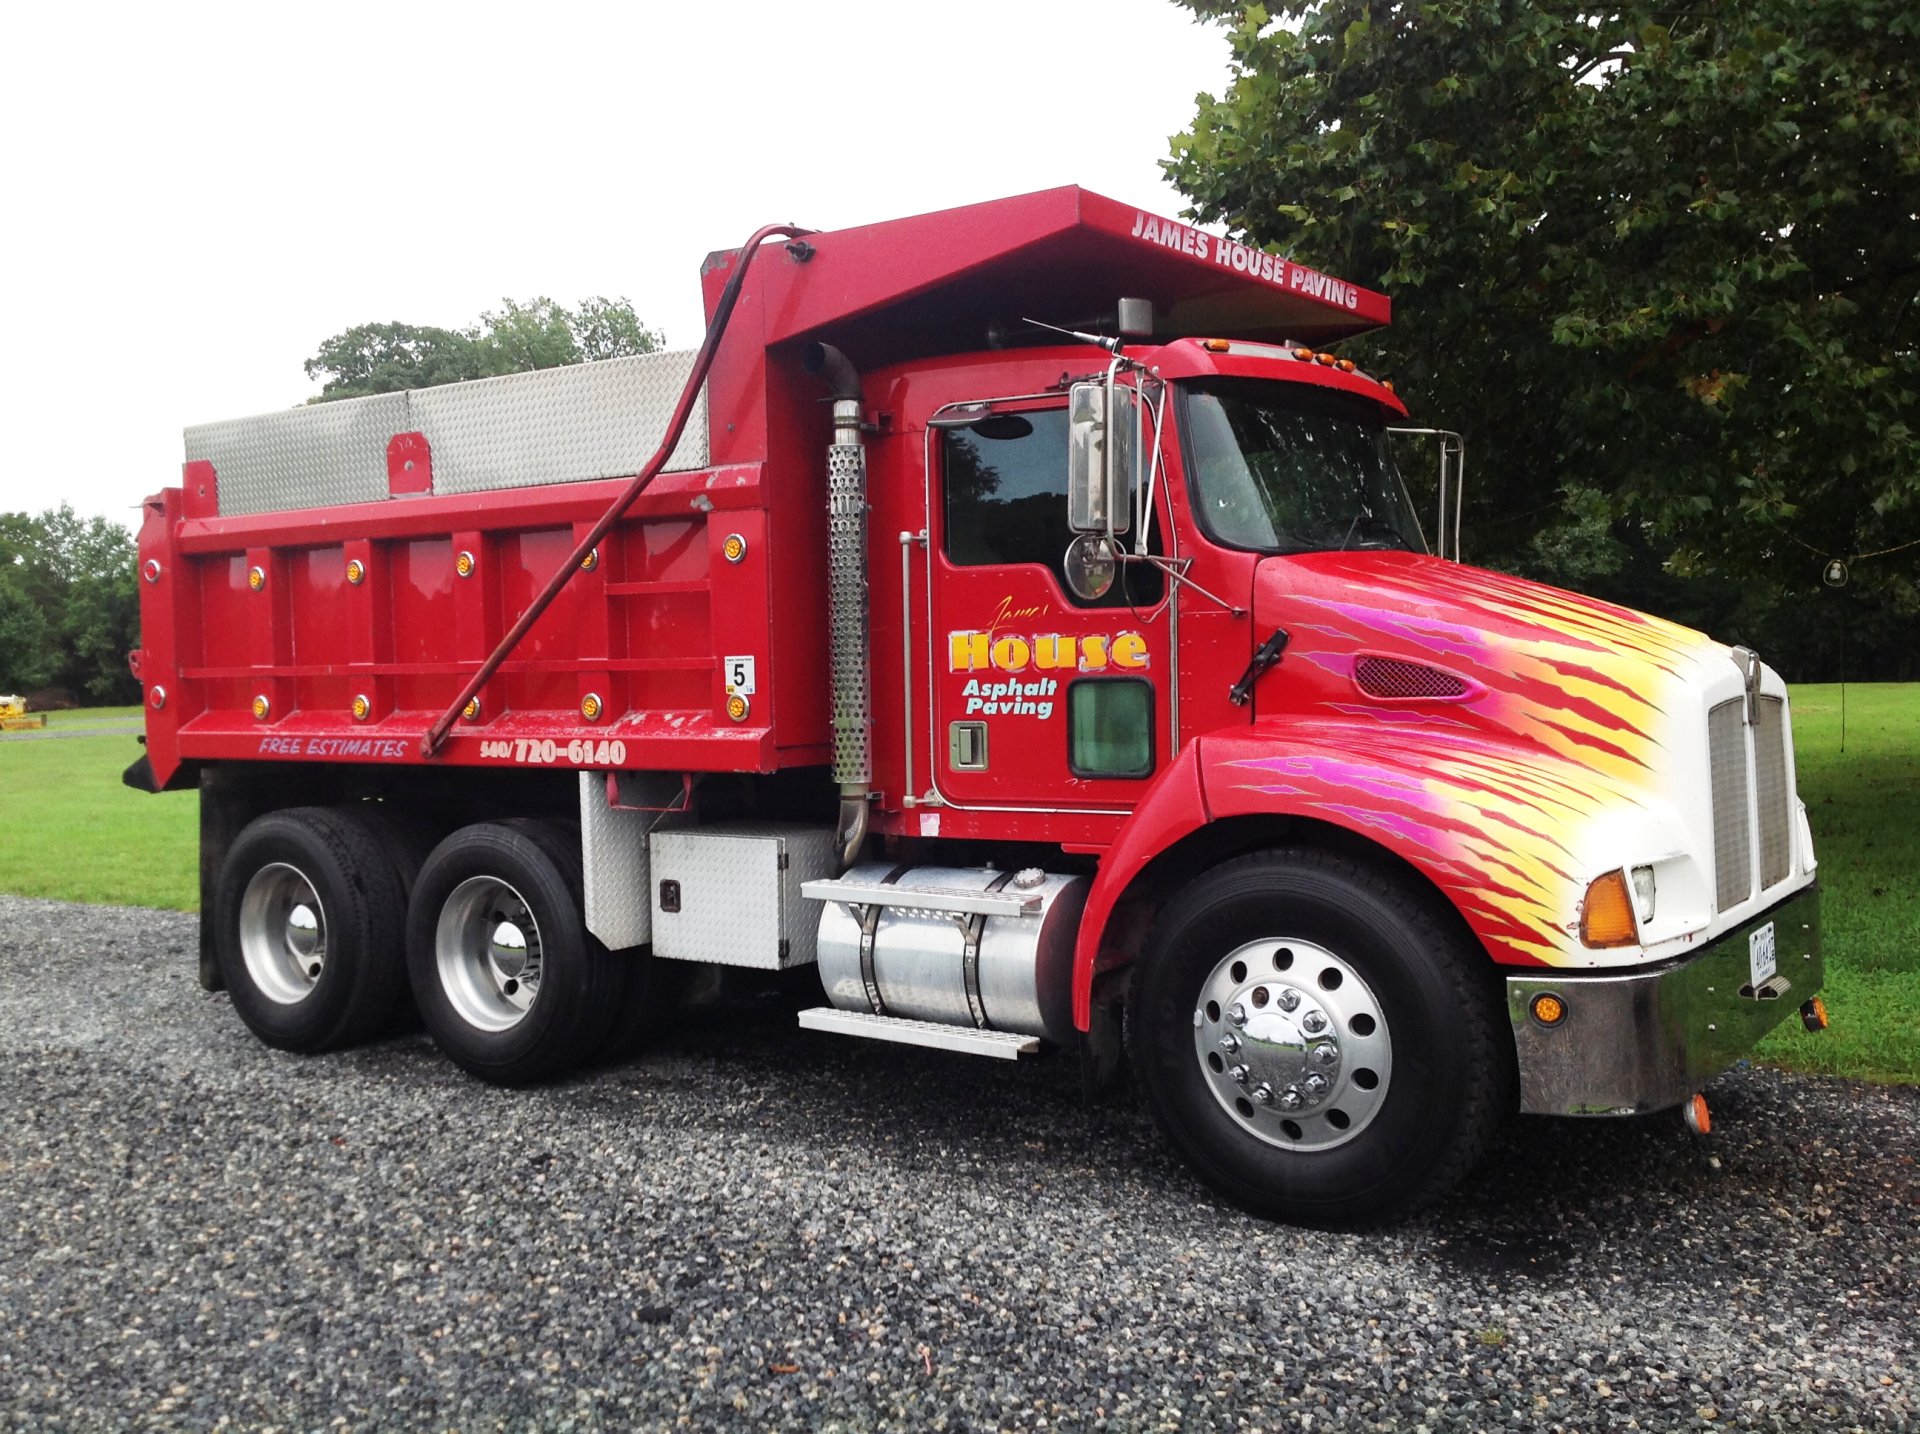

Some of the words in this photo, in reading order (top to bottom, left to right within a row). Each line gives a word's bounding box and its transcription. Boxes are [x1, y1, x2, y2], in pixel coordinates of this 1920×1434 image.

[1131, 212, 1208, 259] JAMES
[1215, 237, 1285, 285] HOUSE
[1291, 267, 1358, 310] PAVING
[948, 630, 1151, 674] House
[733, 663, 745, 687] 5
[962, 677, 1057, 701] Asphalt
[965, 697, 1053, 719] Paving
[259, 737, 303, 755] FREE
[305, 739, 408, 758] ESTIMATES
